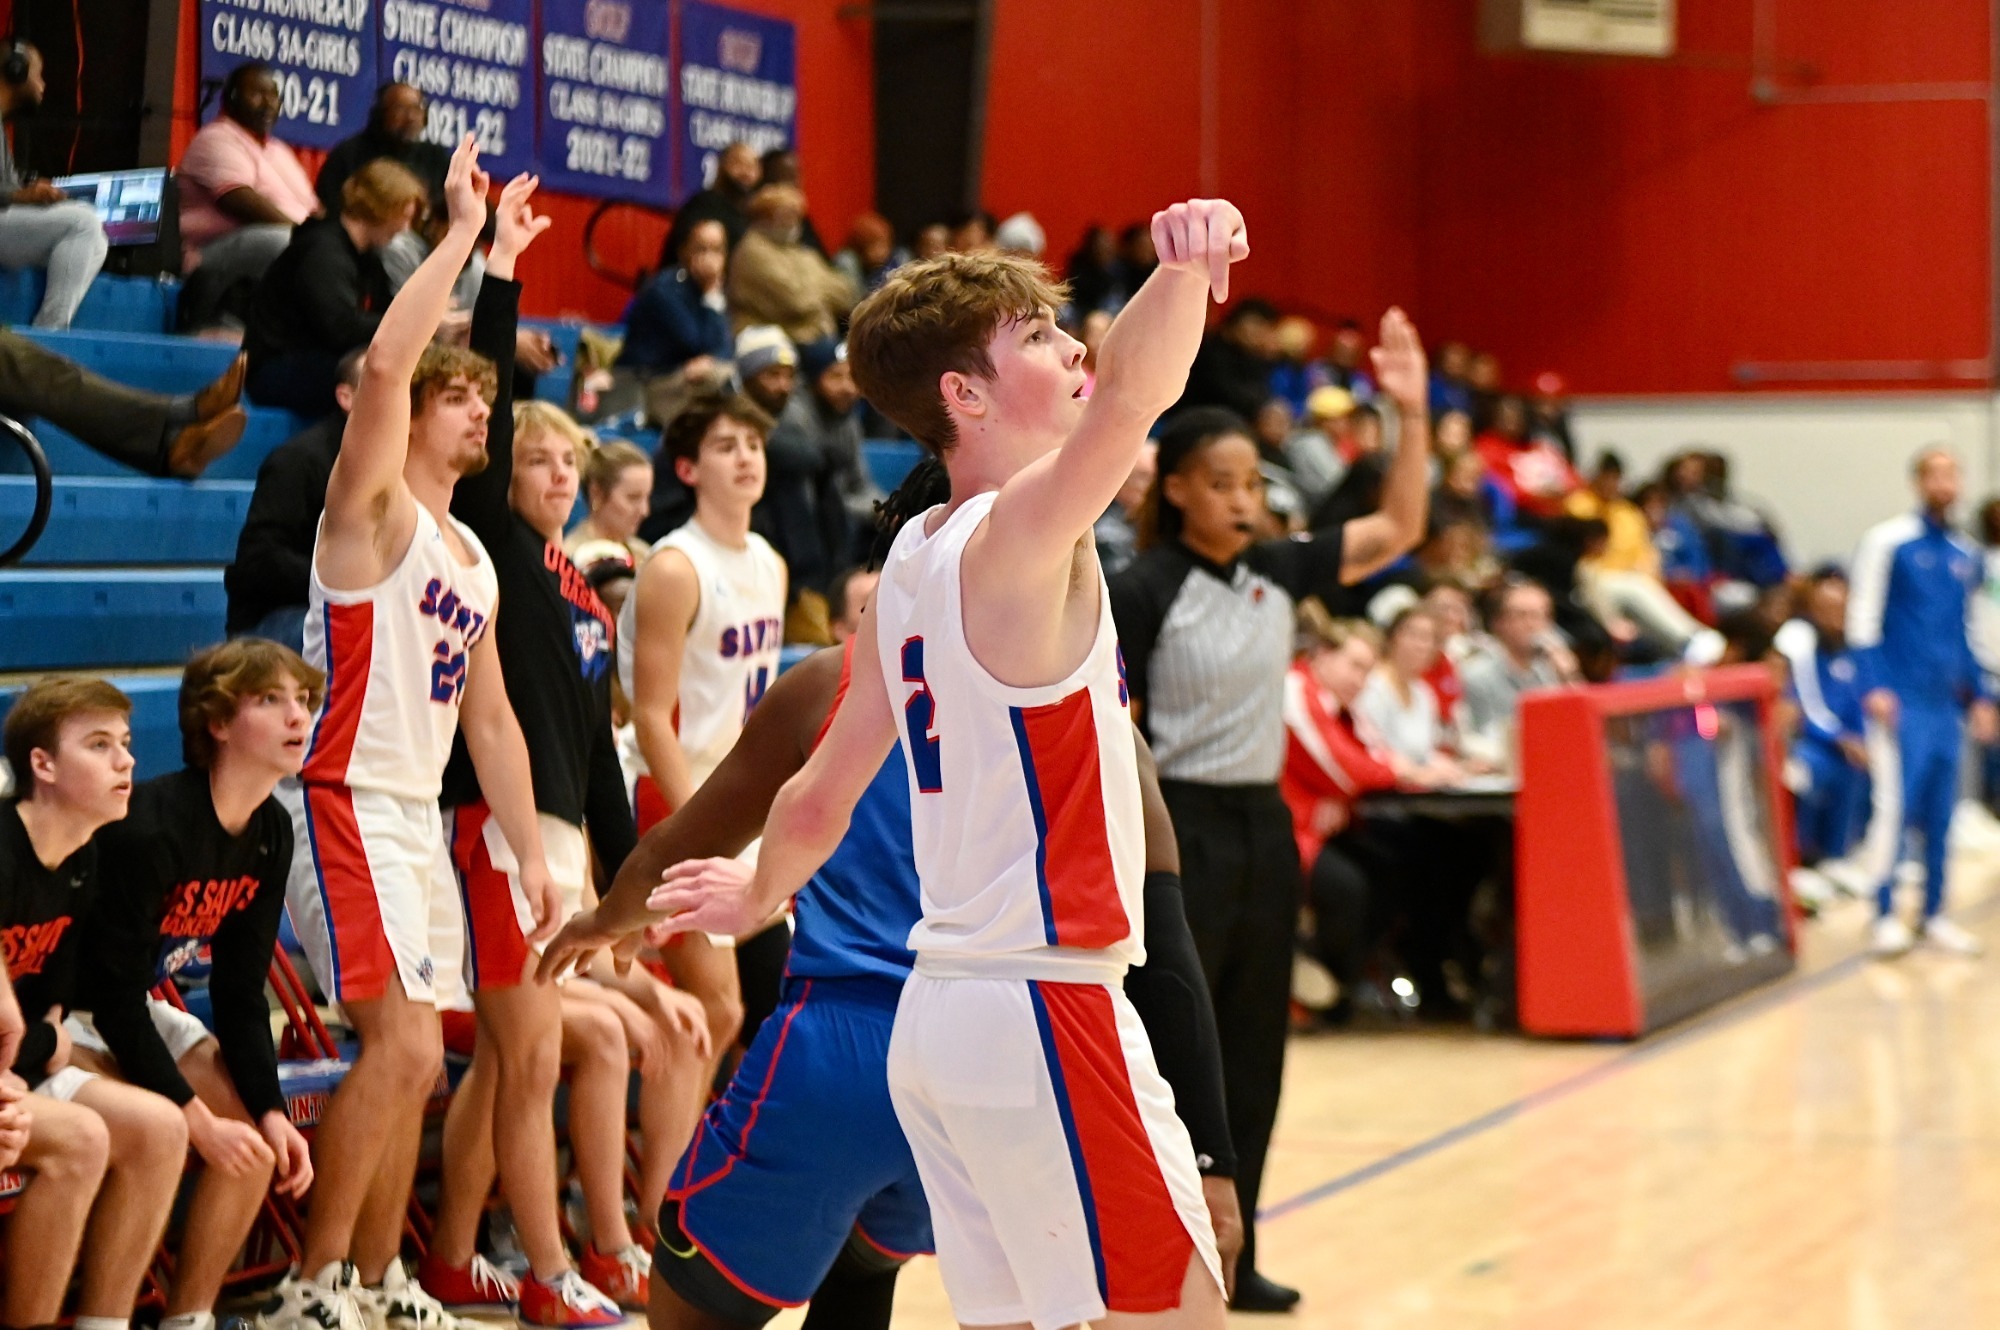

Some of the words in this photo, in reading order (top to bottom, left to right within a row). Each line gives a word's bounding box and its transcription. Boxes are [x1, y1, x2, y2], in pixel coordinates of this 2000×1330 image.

[212, 11, 276, 61] CLASS
[277, 24, 361, 77] 3A-GIRLS
[383, 0, 441, 50] STATE
[439, 8, 529, 67] CHAMPION
[543, 32, 591, 83] STATE
[589, 42, 670, 98] CHAMPION
[393, 48, 450, 96] CLASS
[549, 81, 600, 126] CLASS
[566, 125, 652, 182] 2021-22
[901, 634, 943, 793] 2
